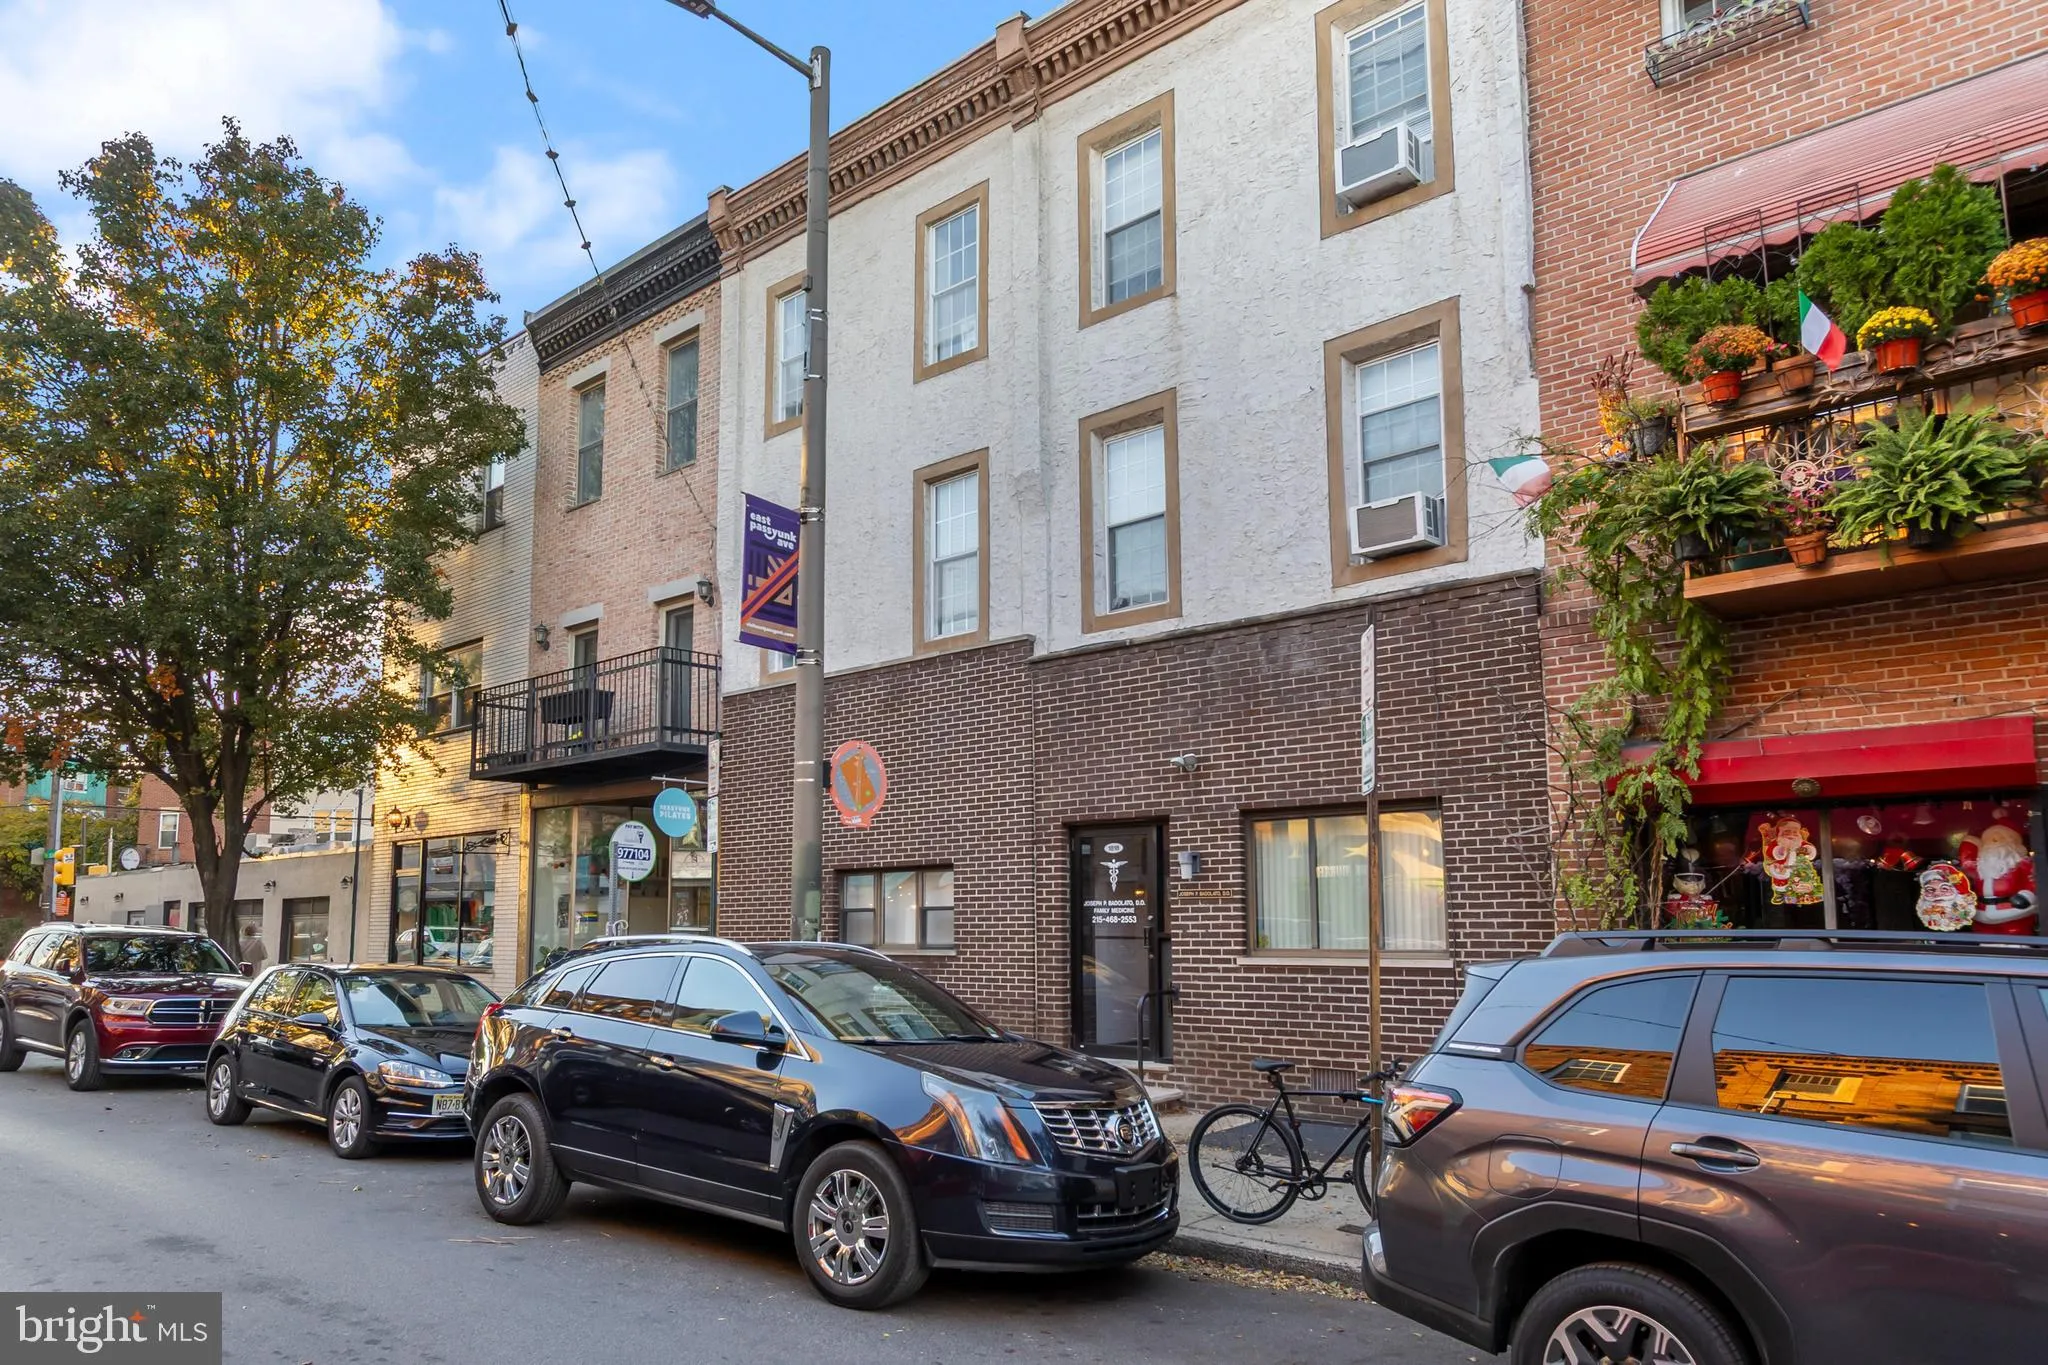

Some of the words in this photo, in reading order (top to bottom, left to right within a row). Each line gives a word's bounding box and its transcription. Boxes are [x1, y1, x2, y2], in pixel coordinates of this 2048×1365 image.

[750, 512, 771, 526] east
[750, 521, 797, 543] passyunk
[776, 538, 795, 550] ave
[660, 811, 691, 820] PILATES
[617, 848, 650, 861] 977104
[1092, 915, 1137, 923] 215-468-2553
